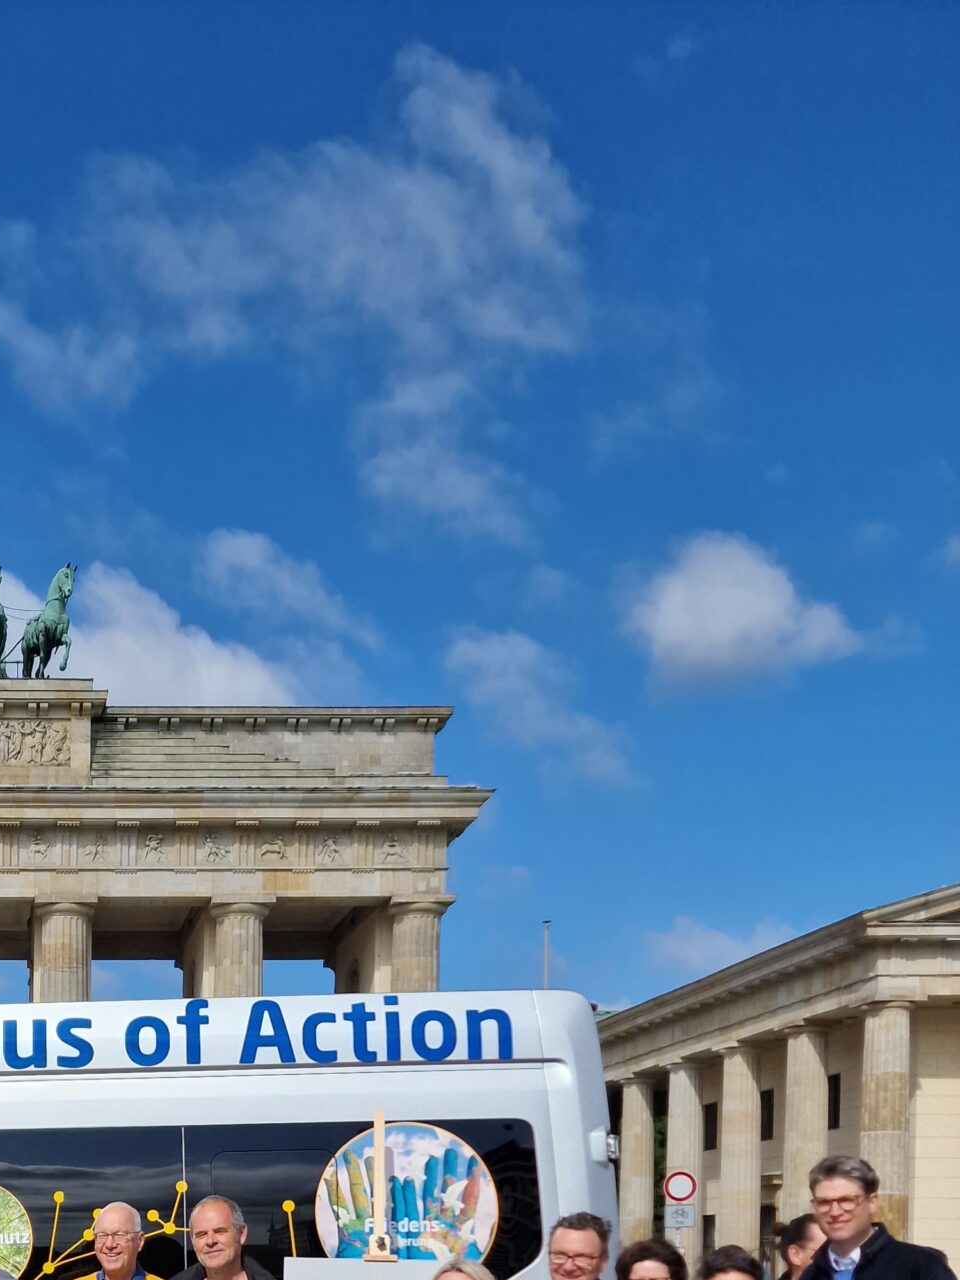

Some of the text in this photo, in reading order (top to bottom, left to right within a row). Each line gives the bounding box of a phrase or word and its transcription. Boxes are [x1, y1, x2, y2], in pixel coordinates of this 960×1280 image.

[125, 998, 209, 1066] of
[239, 995, 513, 1064] Action
[365, 1217, 445, 1233] Fiedens-
